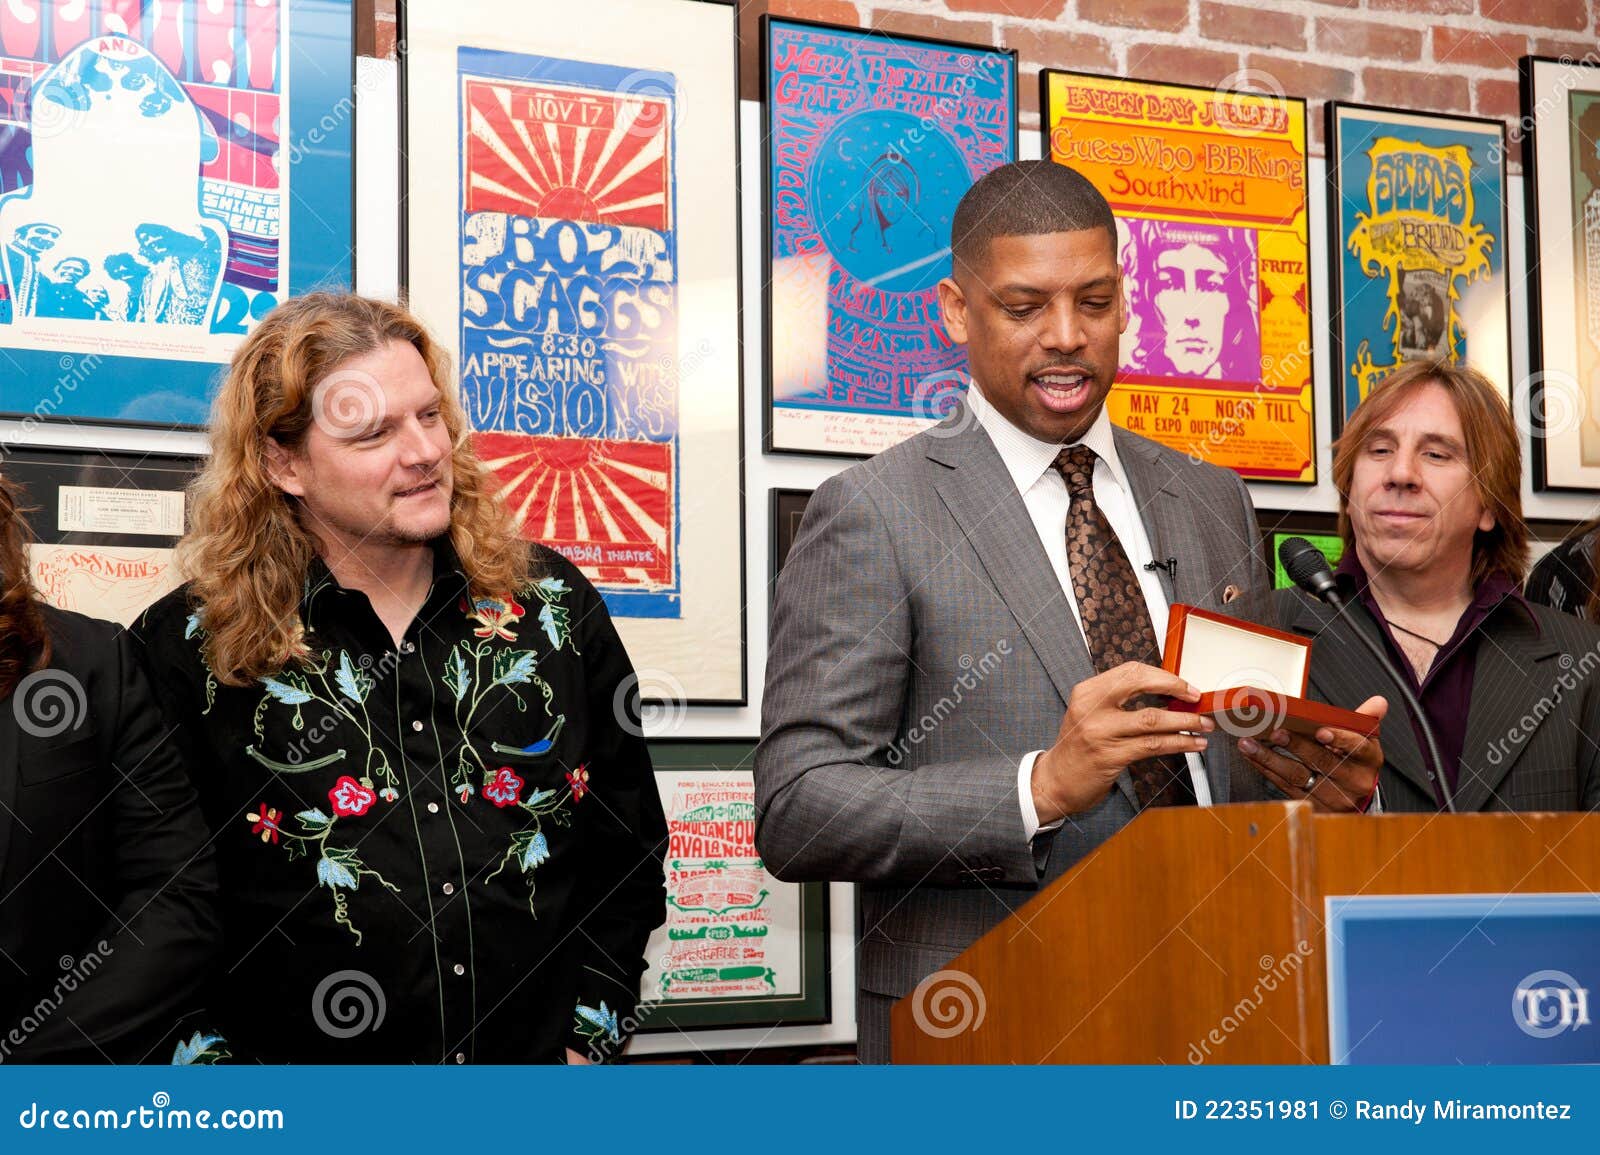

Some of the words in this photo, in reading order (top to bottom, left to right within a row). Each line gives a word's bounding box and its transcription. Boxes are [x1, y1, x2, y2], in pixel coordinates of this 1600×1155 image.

[98, 38, 140, 57] AND
[527, 97, 575, 123] NOV
[580, 100, 604, 124] 17
[1145, 94, 1197, 125] DAY
[1109, 168, 1246, 205] Southwind
[1260, 258, 1305, 276] FRITZ
[463, 265, 677, 338] SCAGGS
[540, 334, 597, 358] 8:30
[463, 352, 606, 385] APPEARING
[463, 375, 676, 443] VISIONS
[1130, 394, 1160, 415] MAY
[1171, 396, 1190, 416] 24
[1214, 399, 1256, 421] NOON
[1264, 402, 1296, 424] TILL
[1126, 415, 1147, 431] CAL
[1154, 417, 1183, 433] EXPO
[1189, 418, 1246, 438] OUTDOORS
[548, 545, 603, 564] AMBRA
[606, 549, 655, 563] THEATER
[729, 804, 755, 821] DANC
[669, 821, 755, 845] SIMULTANEOU
